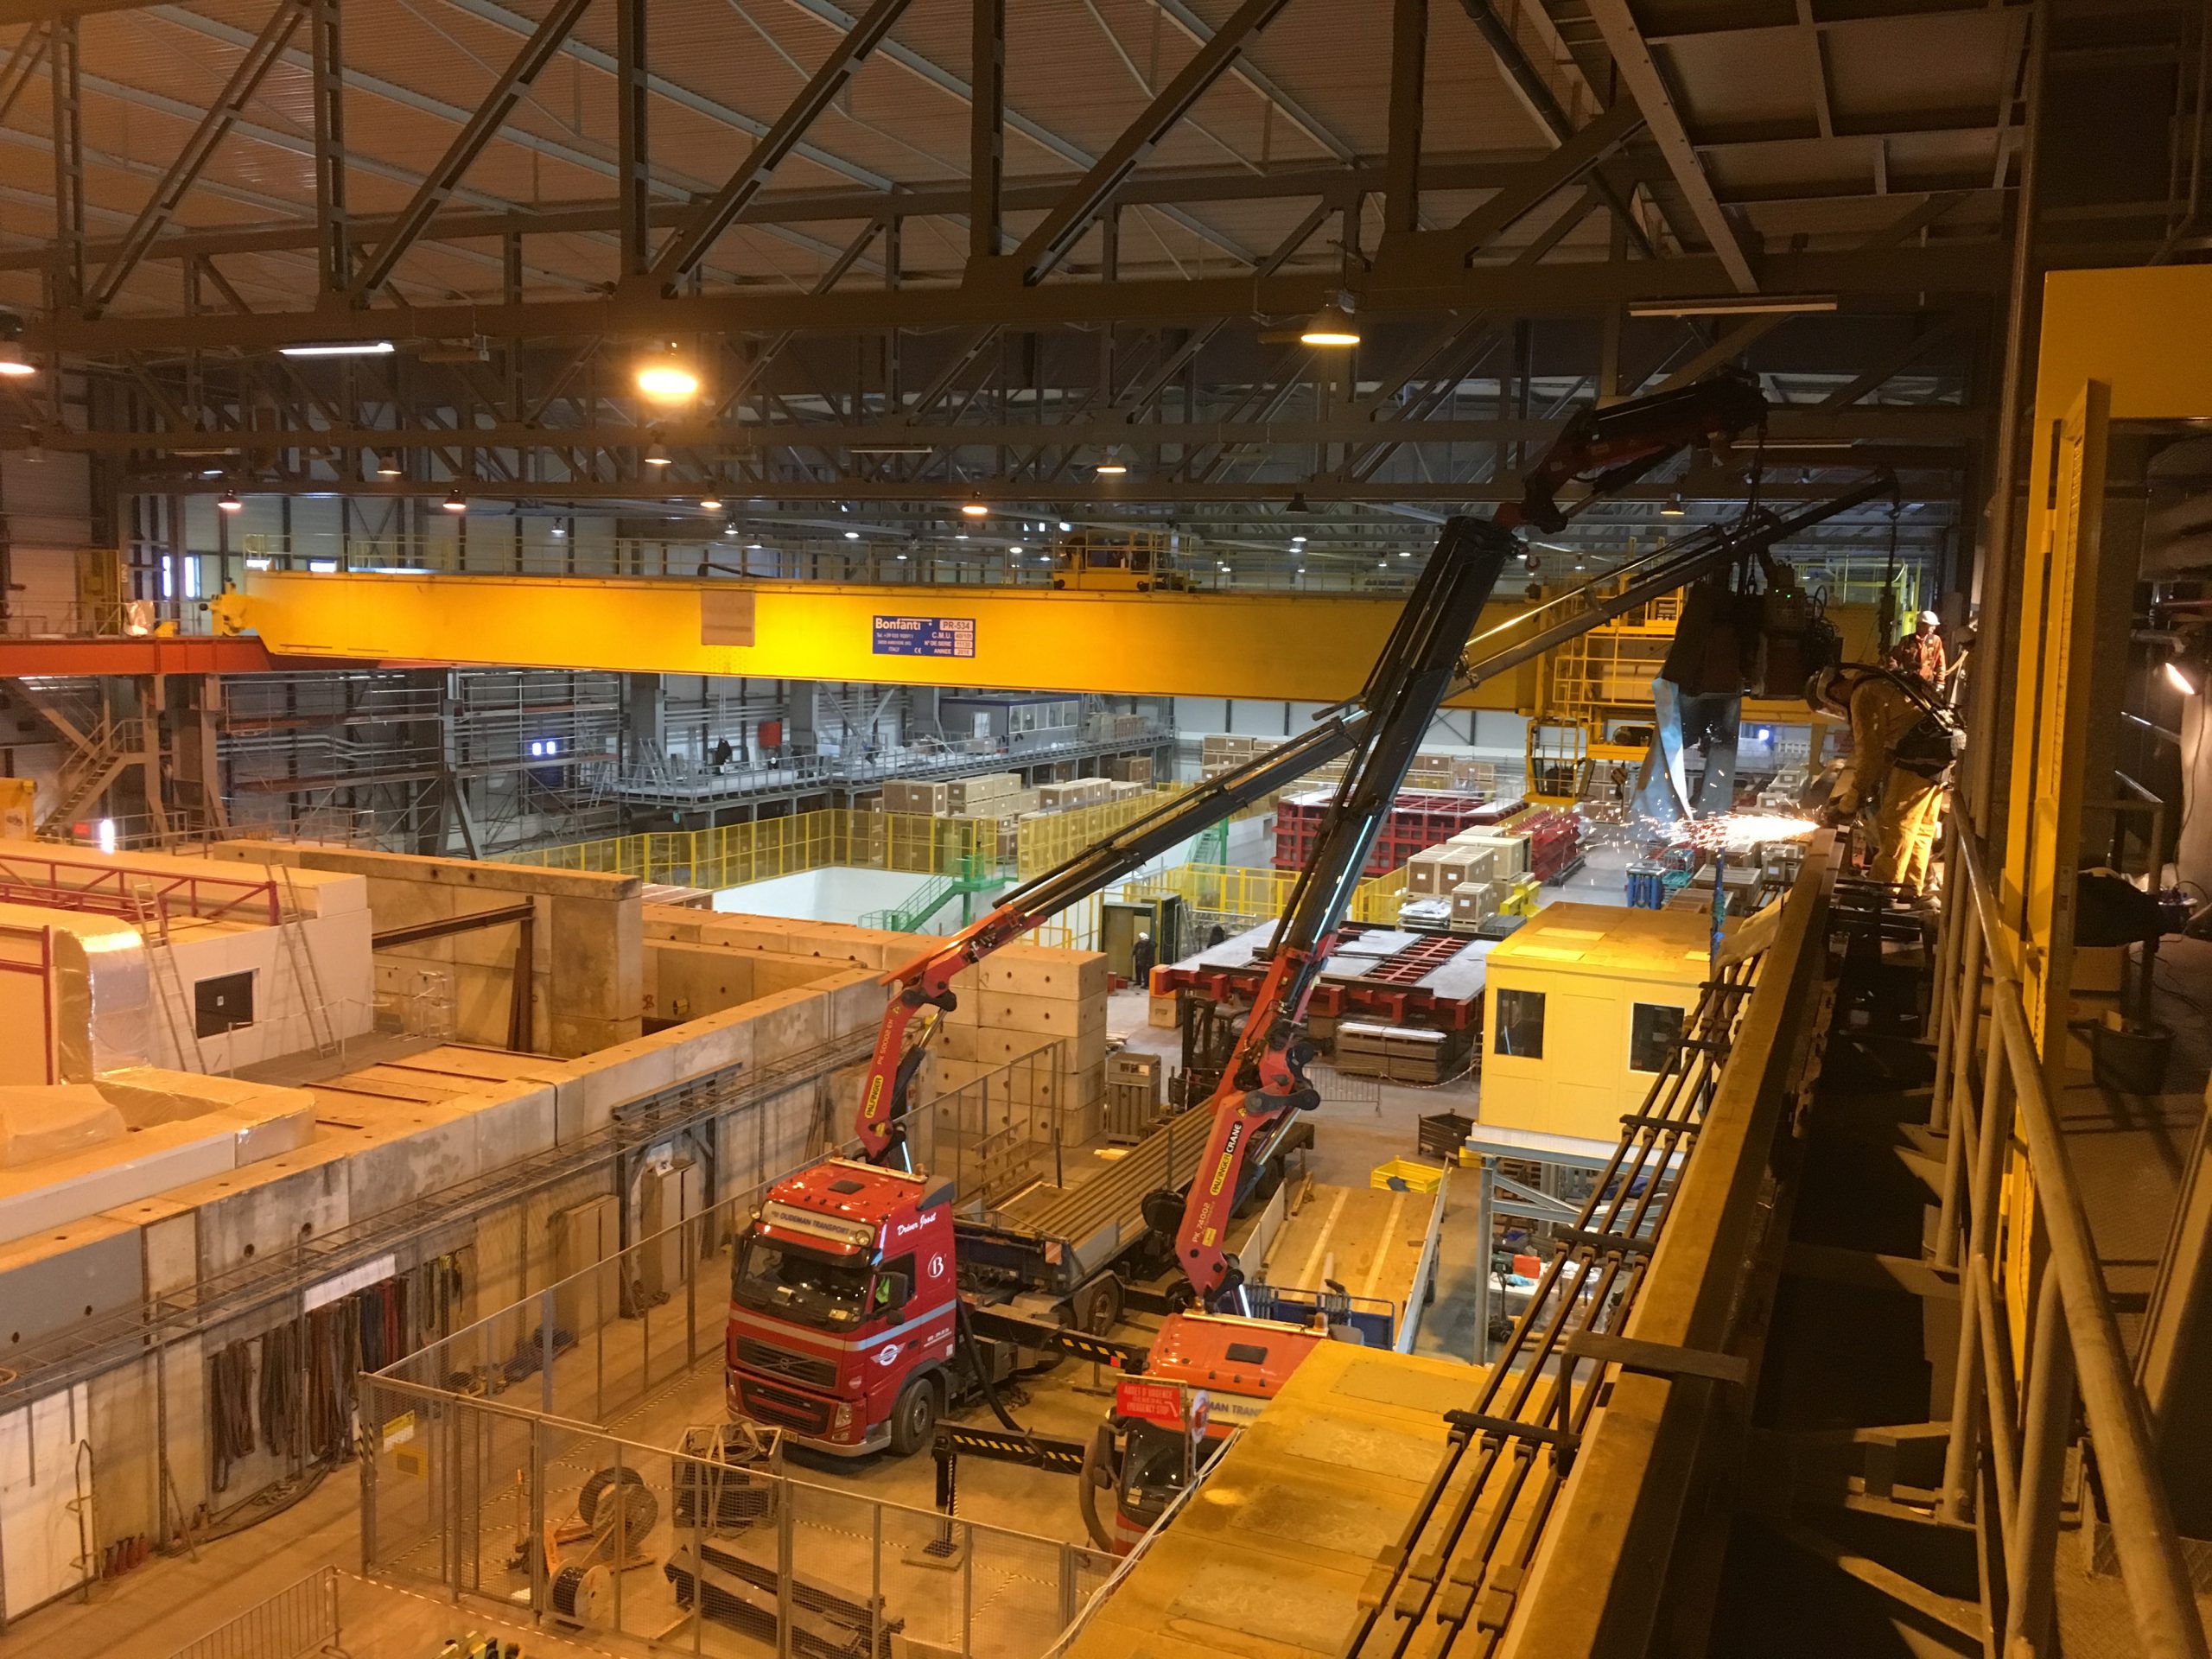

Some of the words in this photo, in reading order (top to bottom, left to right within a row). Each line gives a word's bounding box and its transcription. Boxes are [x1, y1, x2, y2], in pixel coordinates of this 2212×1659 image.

[875, 618, 921, 630] Bonfanti
[867, 1077, 882, 1116] PALFINGER
[1211, 1153, 1232, 1193] PALFINGER
[1225, 1123, 1242, 1154] CRANE
[779, 1212, 811, 1226] OUDEMAN
[811, 1218, 850, 1235] TRANSPORT
[897, 1221, 918, 1236] Driver
[919, 1211, 937, 1230] Joost
[1192, 1231, 1202, 1243] PK
[1197, 1202, 1211, 1230] 74002
